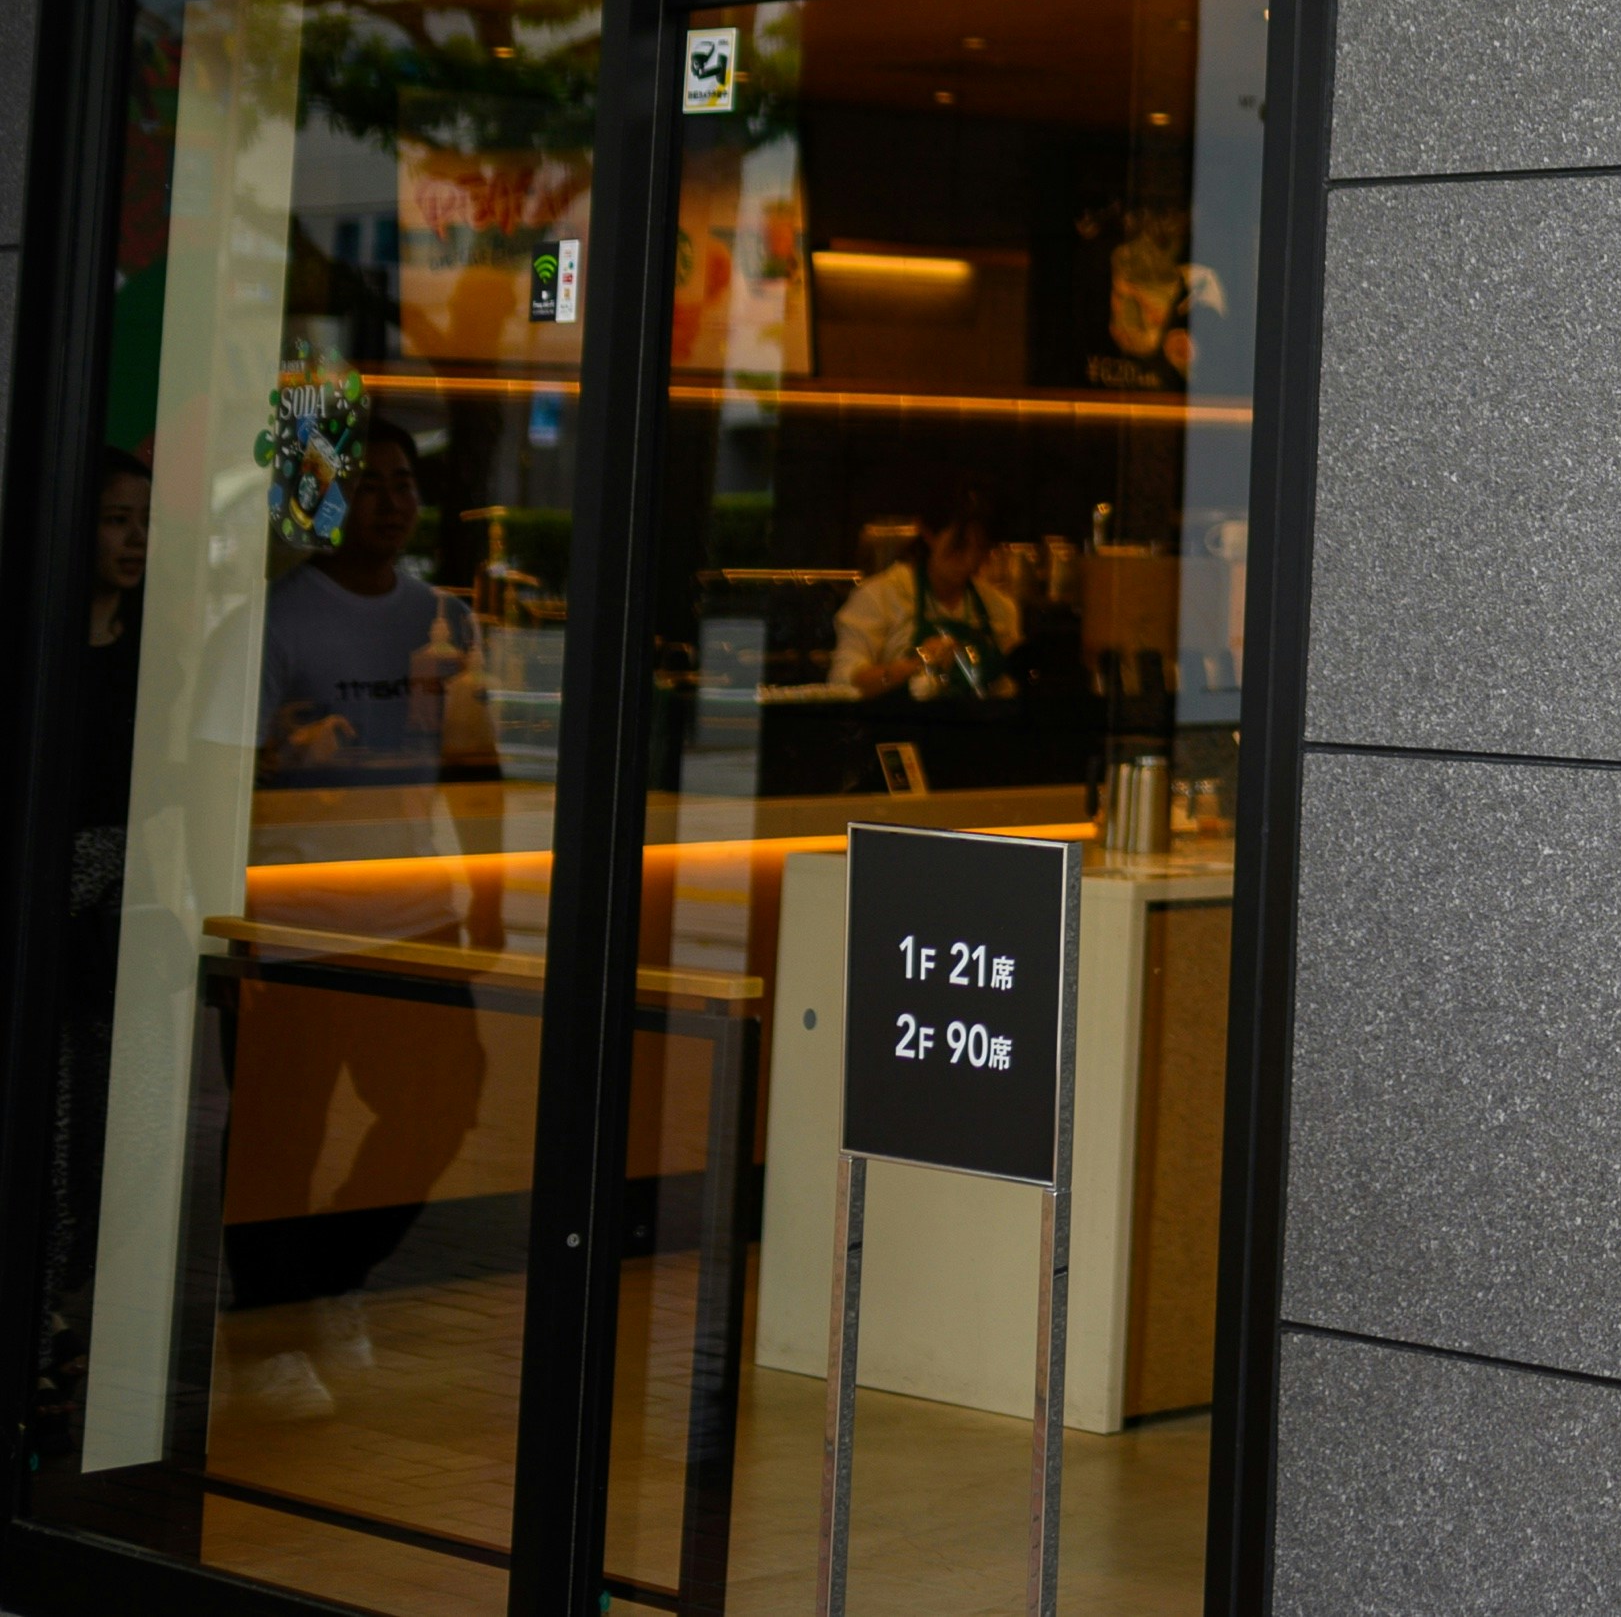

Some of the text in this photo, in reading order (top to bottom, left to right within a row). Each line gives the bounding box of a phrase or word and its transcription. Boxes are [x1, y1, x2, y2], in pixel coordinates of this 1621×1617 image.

[280, 385, 327, 421] SODA
[898, 934, 1016, 991] 1F 21席
[894, 1012, 1013, 1072] 2F 90席
